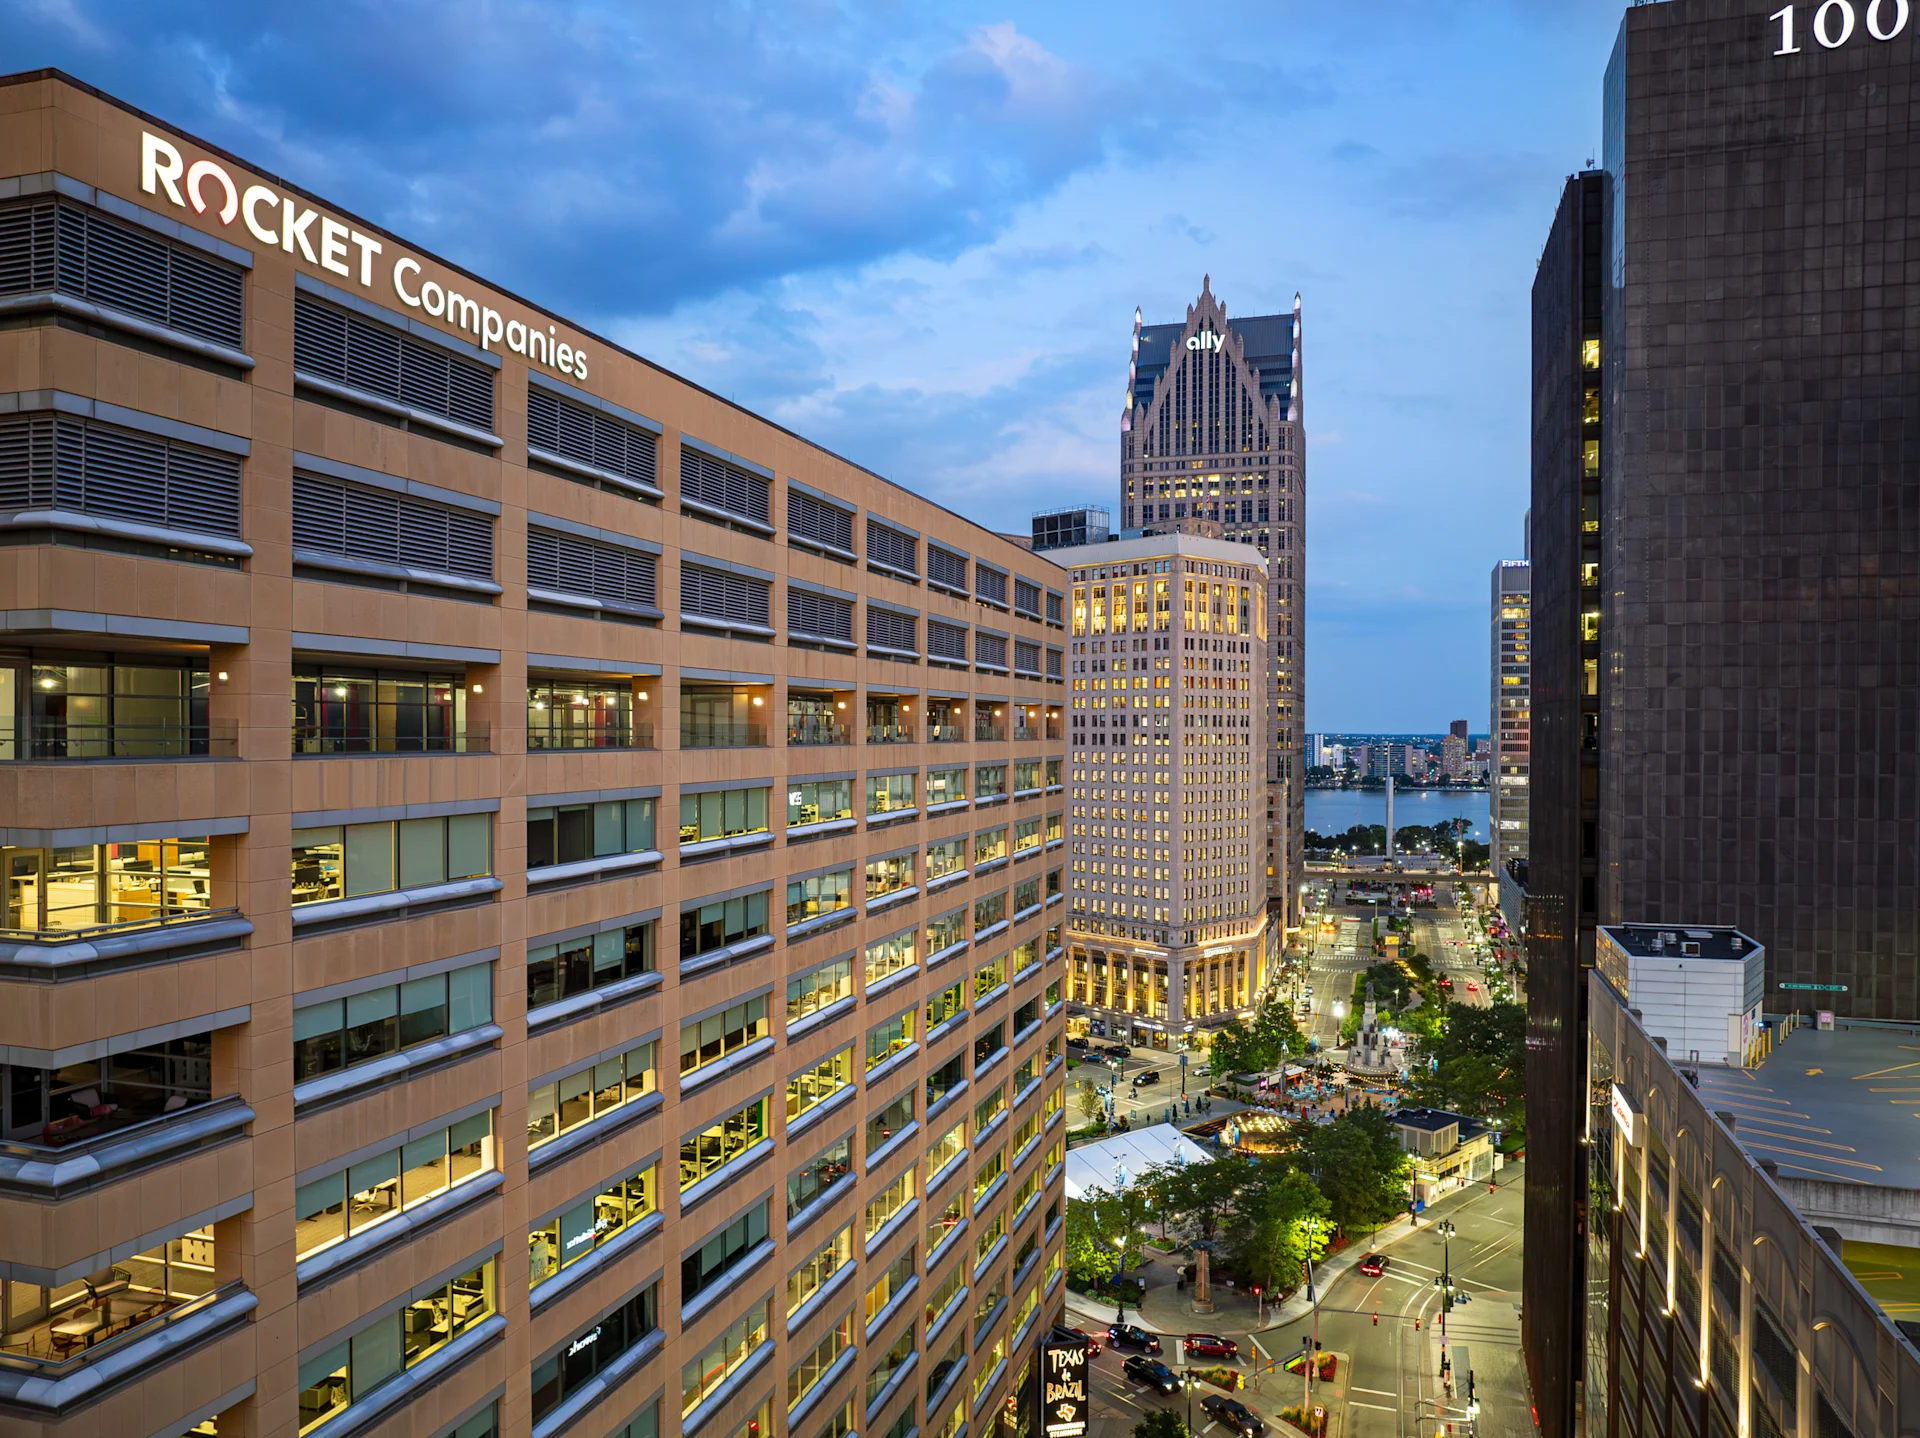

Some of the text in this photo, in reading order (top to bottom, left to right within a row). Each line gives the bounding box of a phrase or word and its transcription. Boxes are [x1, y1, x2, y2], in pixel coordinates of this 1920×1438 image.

[141, 130, 588, 381] ROCKET Companies
[1186, 330, 1226, 353] ally
[1502, 560, 1529, 568] FIFTH
[1048, 1348, 1085, 1373] TEXAS
[1061, 1368, 1072, 1382] de
[1046, 1380, 1086, 1404] BRAZIL
